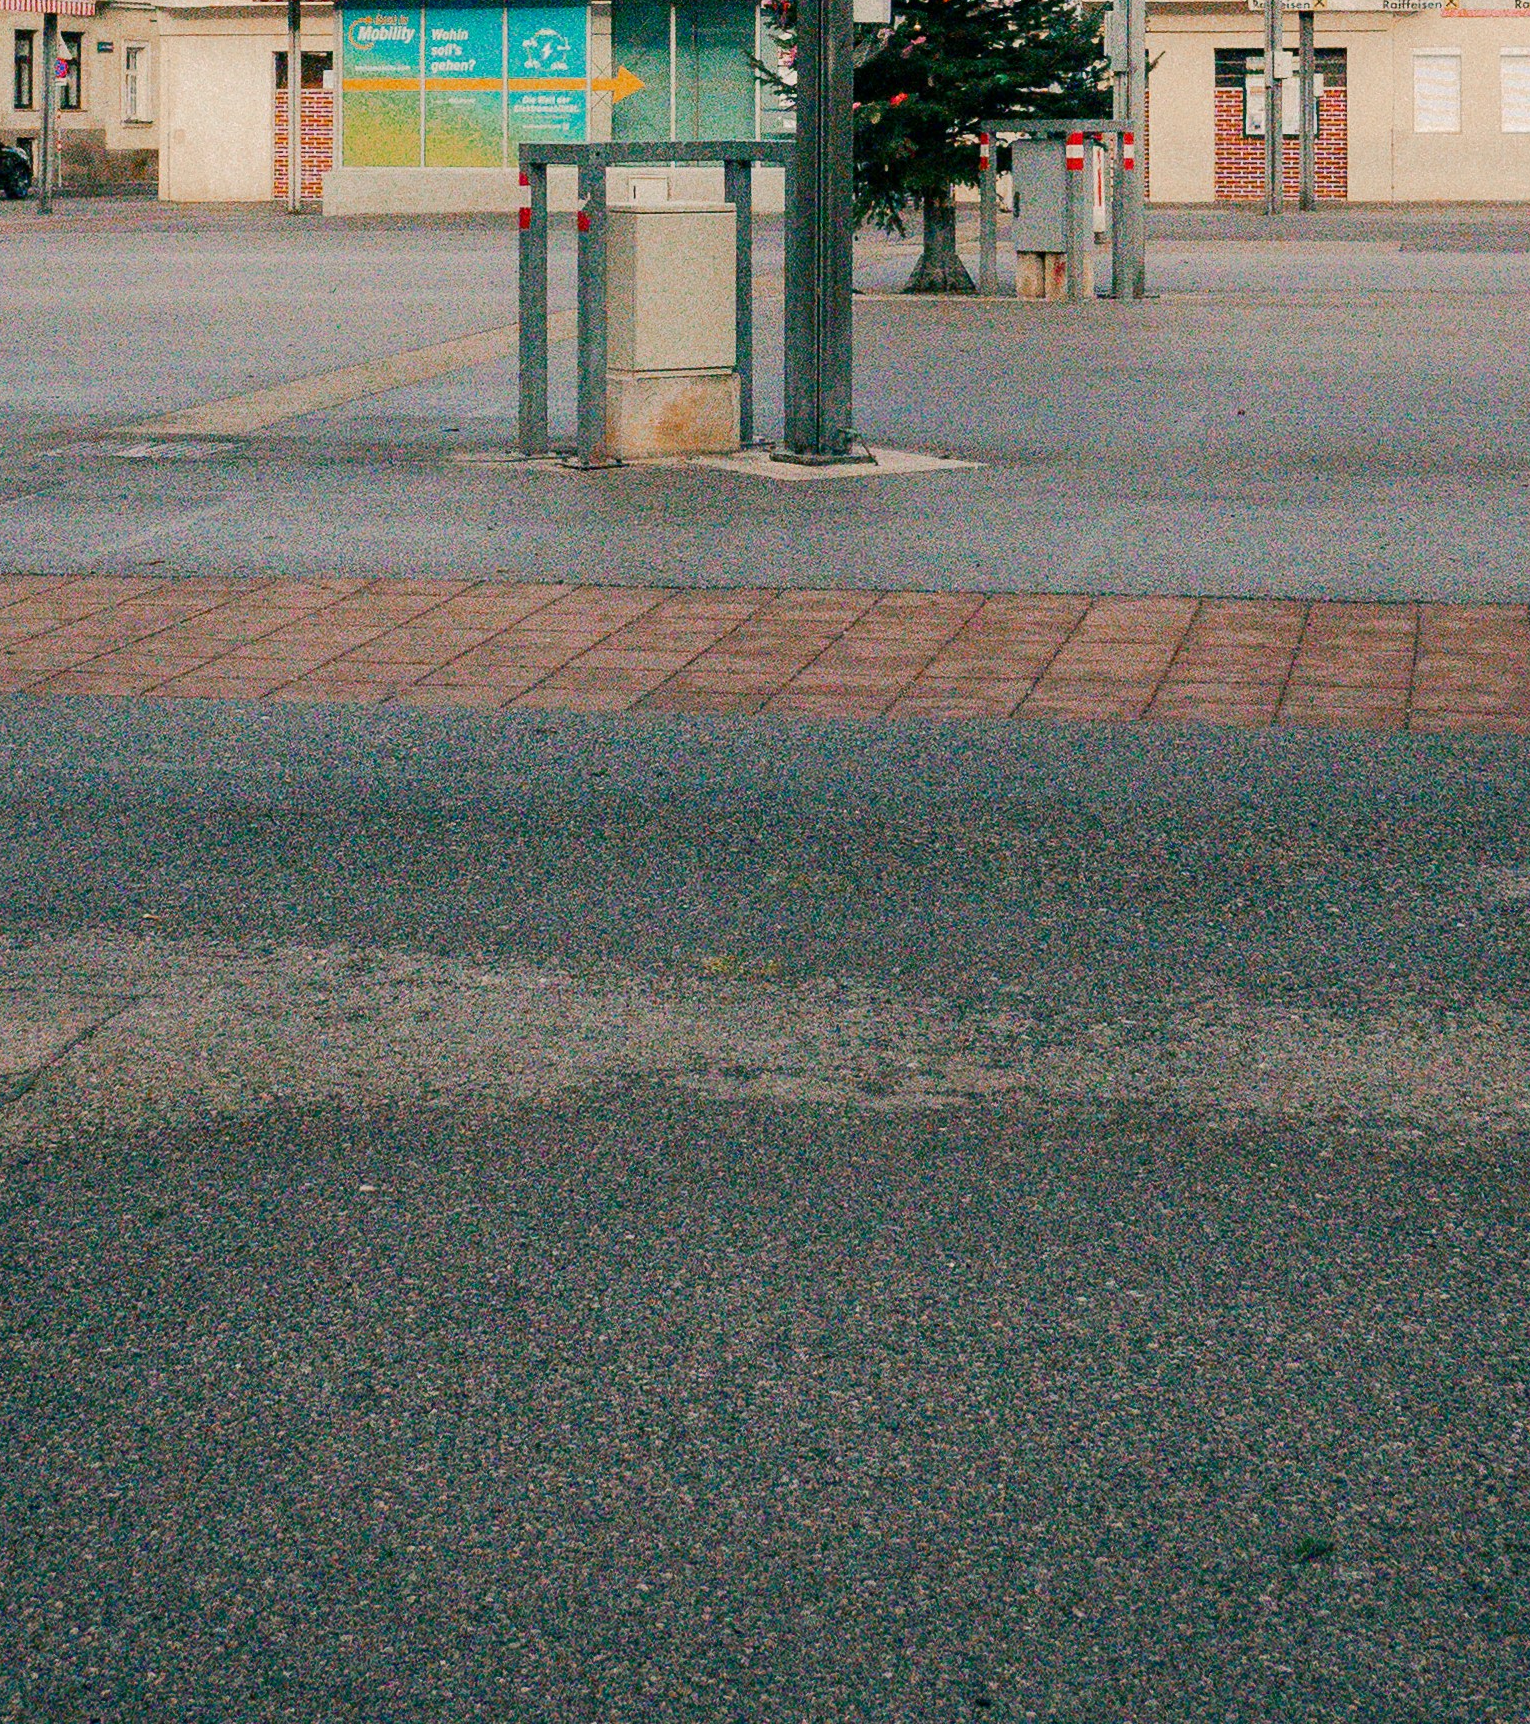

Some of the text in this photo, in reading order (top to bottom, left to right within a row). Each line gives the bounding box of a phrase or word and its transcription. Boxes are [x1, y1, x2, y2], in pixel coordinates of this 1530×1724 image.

[1252, 0, 1310, 9] Raeisen
[1383, 0, 1442, 9] Raiffeisen
[357, 26, 416, 44] Mobility
[431, 28, 469, 41] Wohin
[431, 59, 476, 73] gehen?
